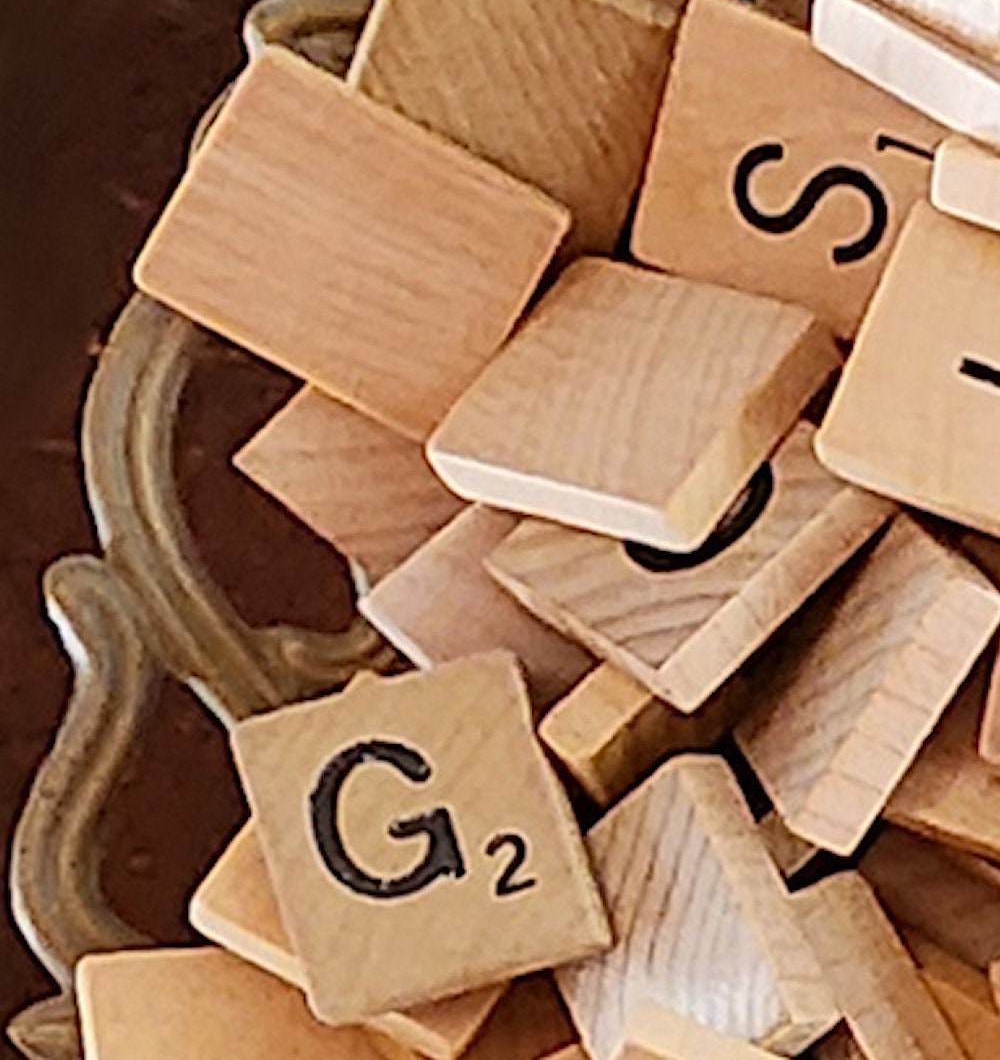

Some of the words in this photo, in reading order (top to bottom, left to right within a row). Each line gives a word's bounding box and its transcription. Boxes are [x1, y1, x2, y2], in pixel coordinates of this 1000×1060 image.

[734, 144, 888, 266] S
[309, 740, 467, 899] G
[485, 834, 535, 896] 2
